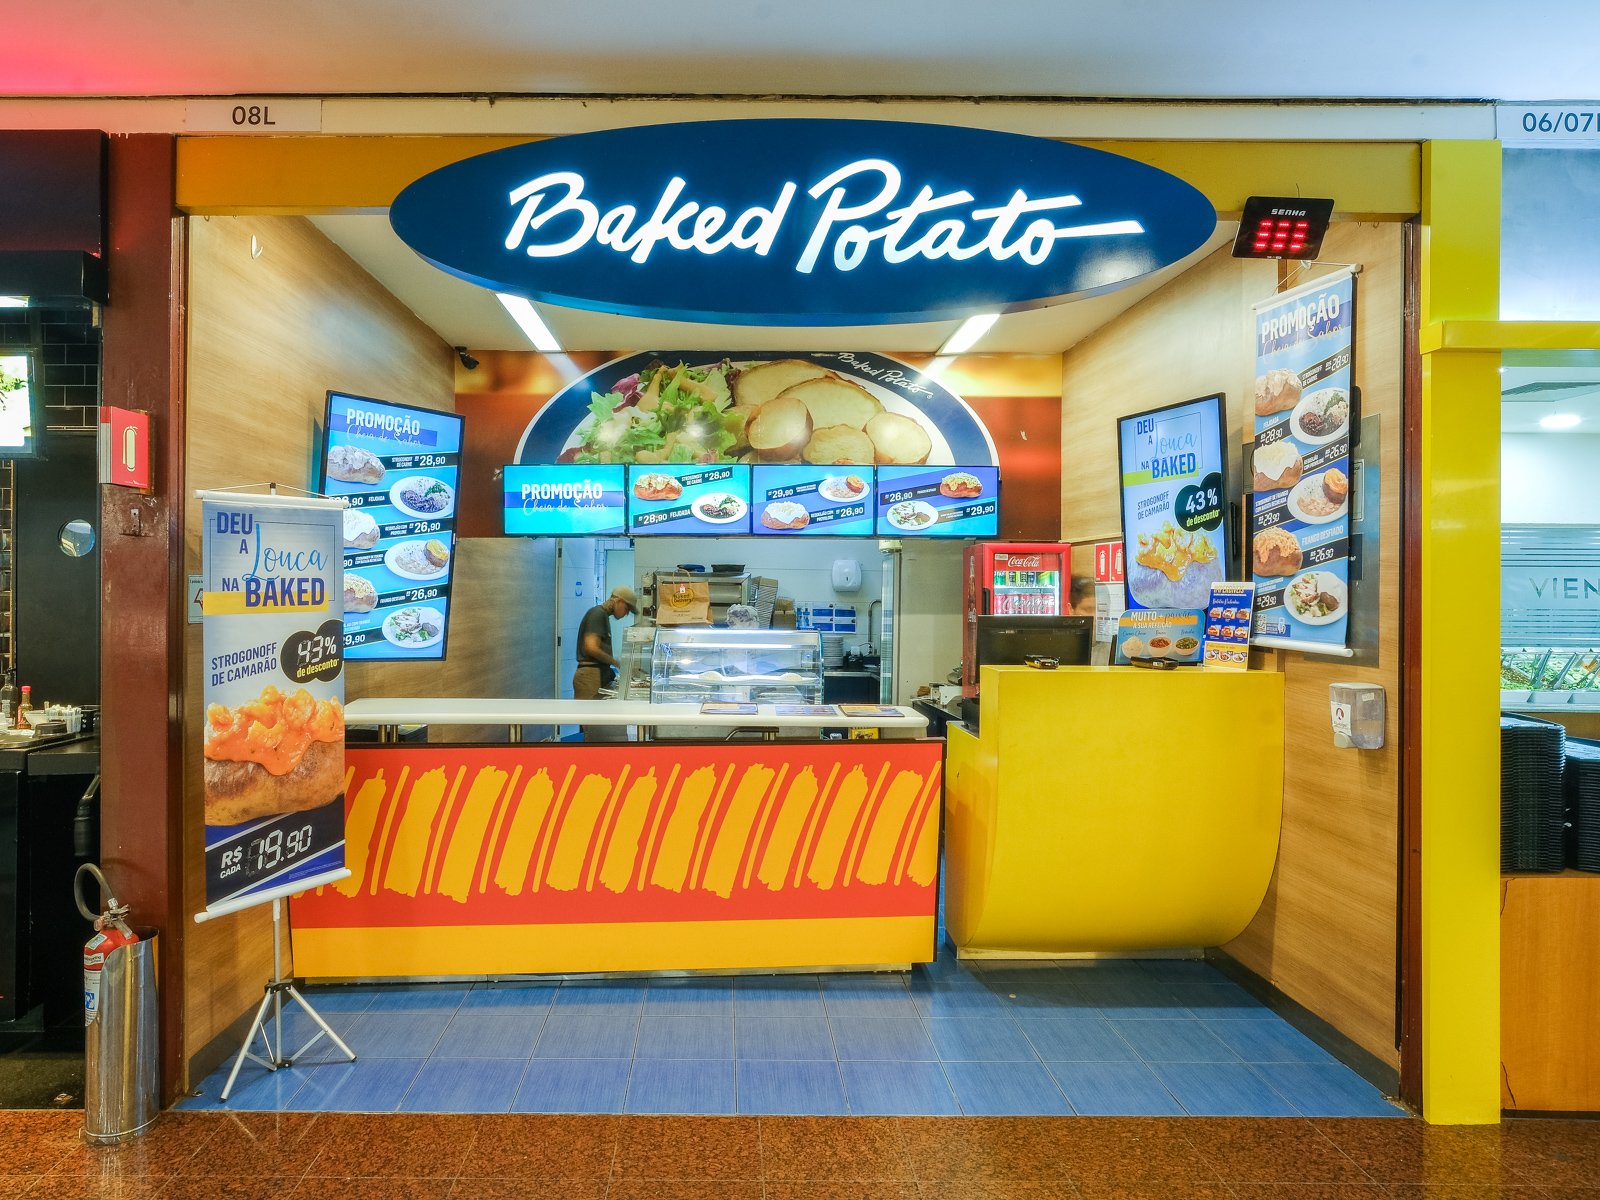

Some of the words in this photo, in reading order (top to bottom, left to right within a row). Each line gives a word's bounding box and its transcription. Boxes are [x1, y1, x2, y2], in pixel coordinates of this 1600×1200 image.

[232, 106, 276, 125] 08L
[505, 171, 798, 264] Baked
[795, 159, 1146, 275] Potato
[1270, 208, 1307, 217] SENHA
[1261, 292, 1340, 344] PROMOÇÃO
[837, 352, 884, 377] Baked
[878, 369, 933, 396] Potato
[346, 407, 421, 436] PROMOÇÃO
[1136, 417, 1155, 436] DEU
[1148, 434, 1153, 445] A
[1151, 422, 1198, 462] Louca
[419, 455, 446, 466] 28,90
[1141, 459, 1150, 471] NA
[1151, 452, 1197, 479] BAKED
[521, 479, 603, 503] PROMOÇÃO
[1137, 490, 1170, 511] STROGONOFF
[1185, 487, 1218, 513] 43%
[336, 496, 363, 508] 8,90
[1137, 509, 1145, 521] DE
[1145, 500, 1170, 518] CAMARÃO
[216, 511, 253, 535] DEU
[414, 521, 441, 533] 26,90
[1186, 517, 1194, 528] de
[1194, 508, 1219, 525] desconto
[239, 538, 249, 554] A
[242, 523, 329, 582] Louca
[1007, 555, 1041, 568] Coca-Cola
[222, 577, 240, 592] NA
[245, 577, 325, 608] BAKED
[411, 588, 438, 601] 26,90
[1130, 610, 1157, 622] MUITO
[343, 634, 366, 646] 9,90
[211, 641, 277, 671] STROGONOFF
[296, 634, 337, 668] 43%
[211, 671, 225, 687] DE
[227, 656, 277, 683] CAMARÃO
[296, 666, 306, 679] de
[306, 658, 336, 675] desconto
[220, 845, 243, 869] R$
[219, 863, 242, 879] CADA
